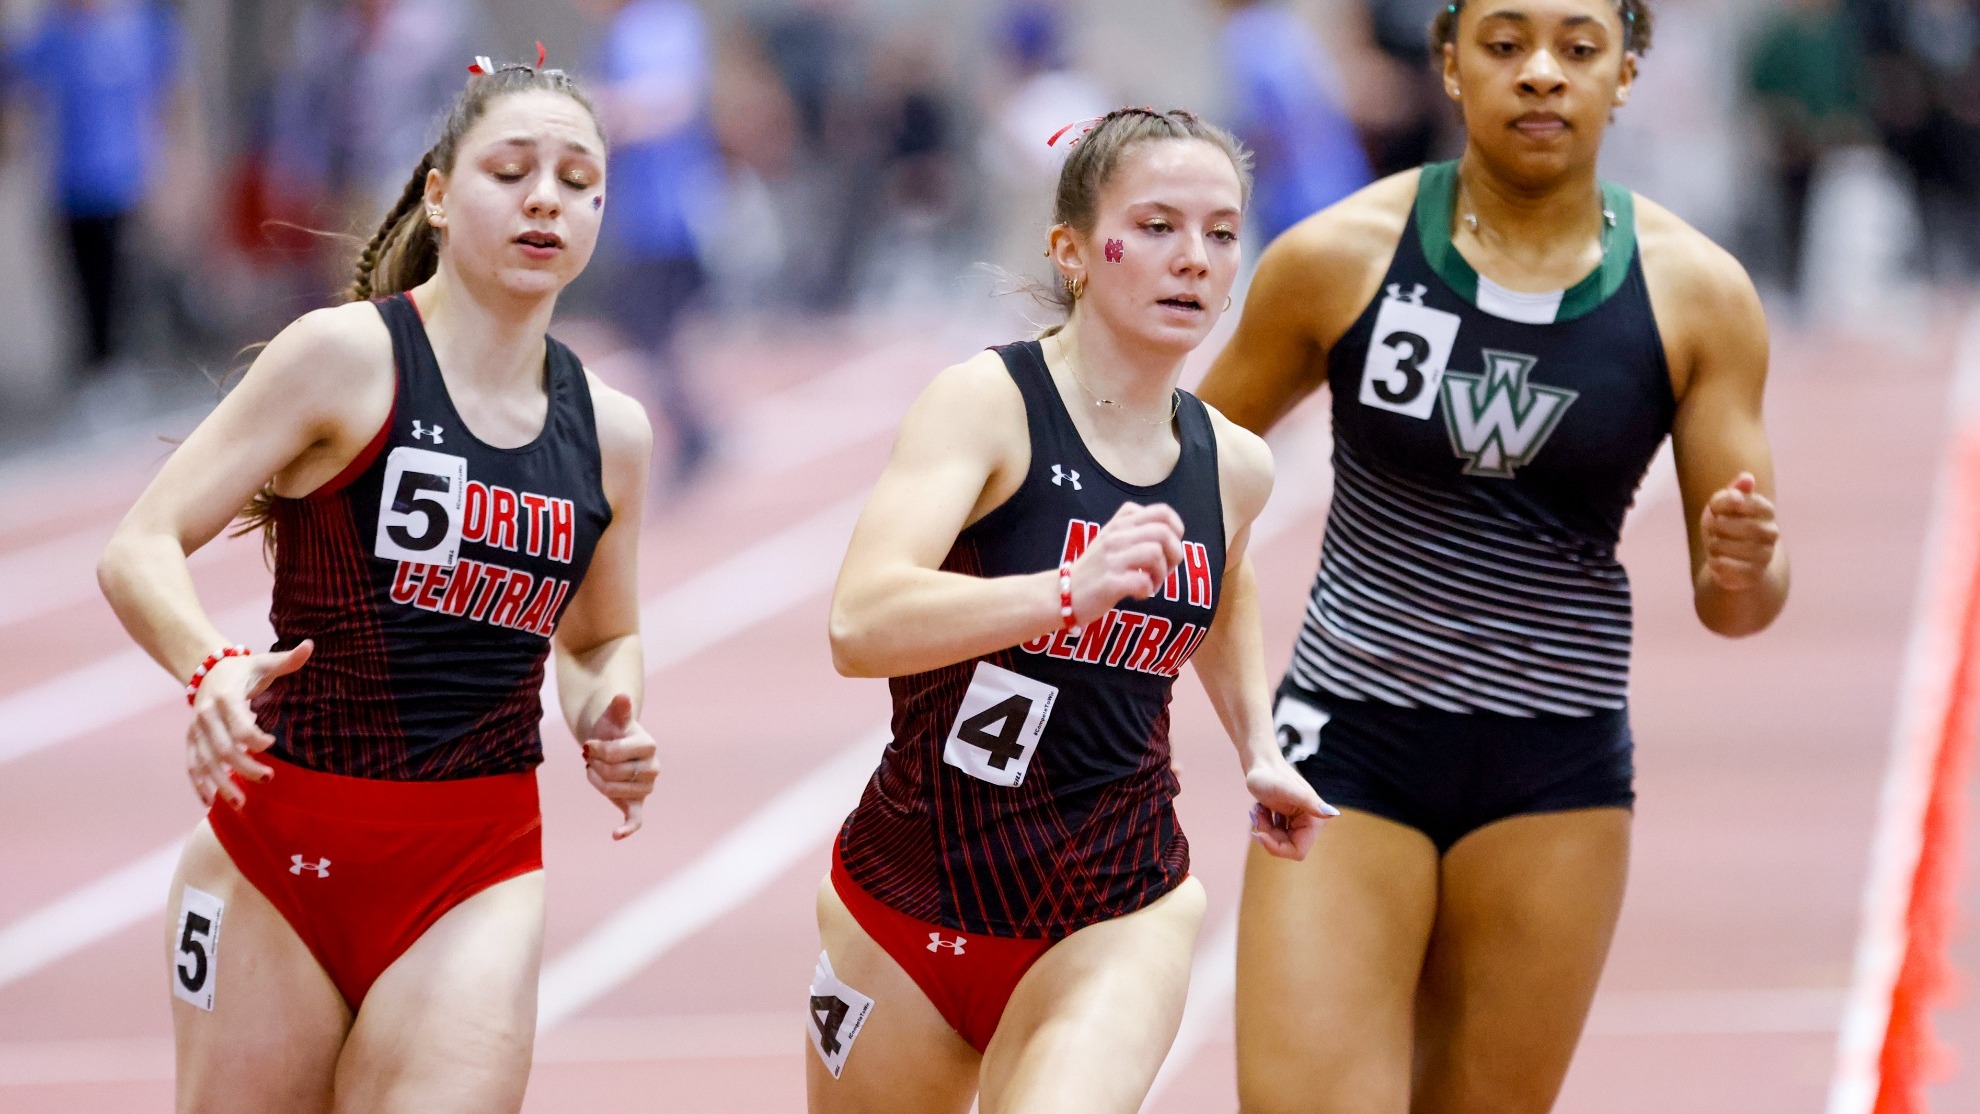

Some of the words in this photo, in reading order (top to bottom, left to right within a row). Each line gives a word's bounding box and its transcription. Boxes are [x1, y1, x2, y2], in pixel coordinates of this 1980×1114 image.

[1372, 331, 1430, 405] 3
[386, 470, 450, 551] 5
[461, 480, 575, 564] ORTH
[390, 557, 570, 638] CENTRAL
[957, 694, 1034, 771] 4
[178, 911, 211, 993] 5
[809, 995, 850, 1058] 4
